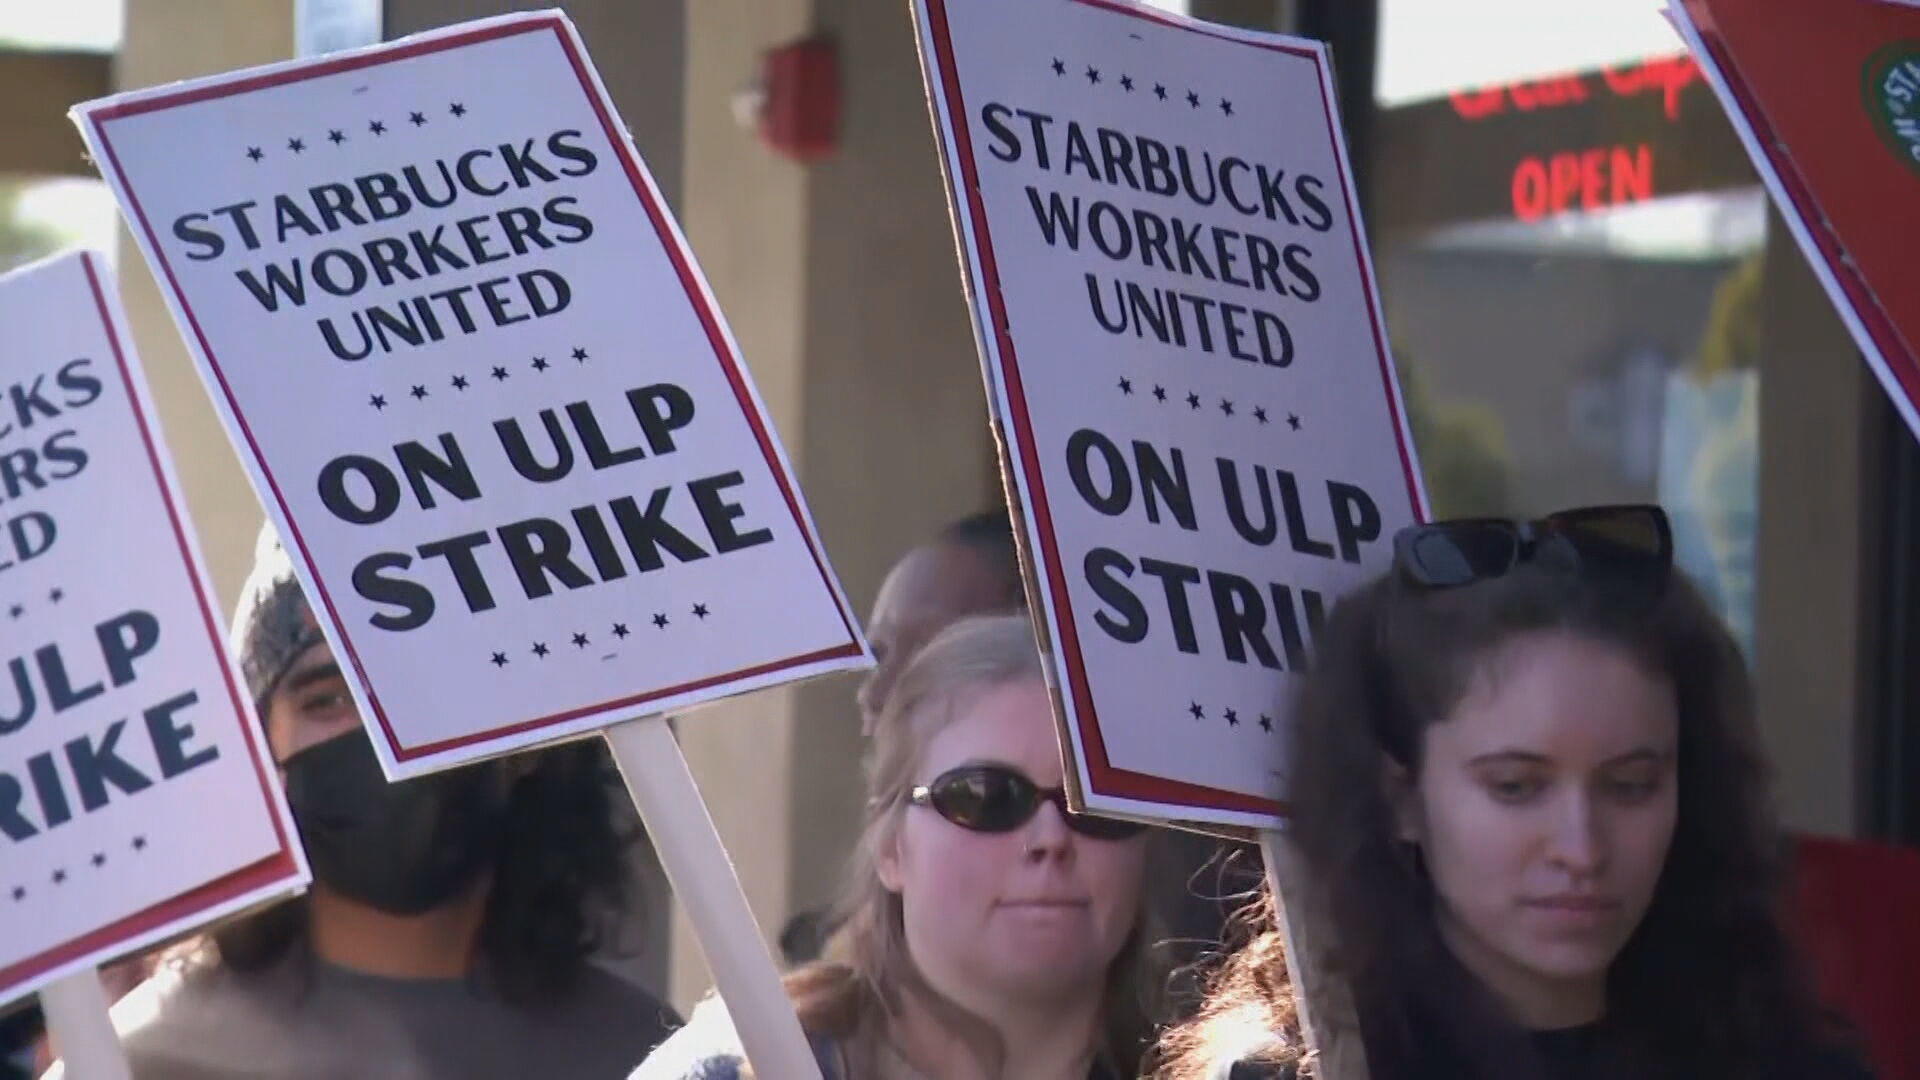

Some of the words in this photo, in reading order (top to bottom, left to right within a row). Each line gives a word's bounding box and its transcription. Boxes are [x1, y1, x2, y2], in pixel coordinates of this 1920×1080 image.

[172, 128, 599, 262] STARBUCKS
[980, 101, 1336, 235] STARBUCKS
[1511, 144, 1654, 222] OPEN
[234, 194, 595, 313] WORKERS
[1023, 184, 1323, 305] WORKERS
[315, 268, 573, 363] UNITED
[1083, 271, 1296, 370] UNITED
[0, 358, 104, 440] KS
[316, 431, 484, 527] ON
[492, 381, 697, 485] ULP
[0, 429, 89, 504] RS
[1065, 427, 1200, 533] ON
[1213, 456, 1383, 566] ULP
[350, 469, 776, 634] STRIKE
[1082, 546, 1326, 675] STRI
